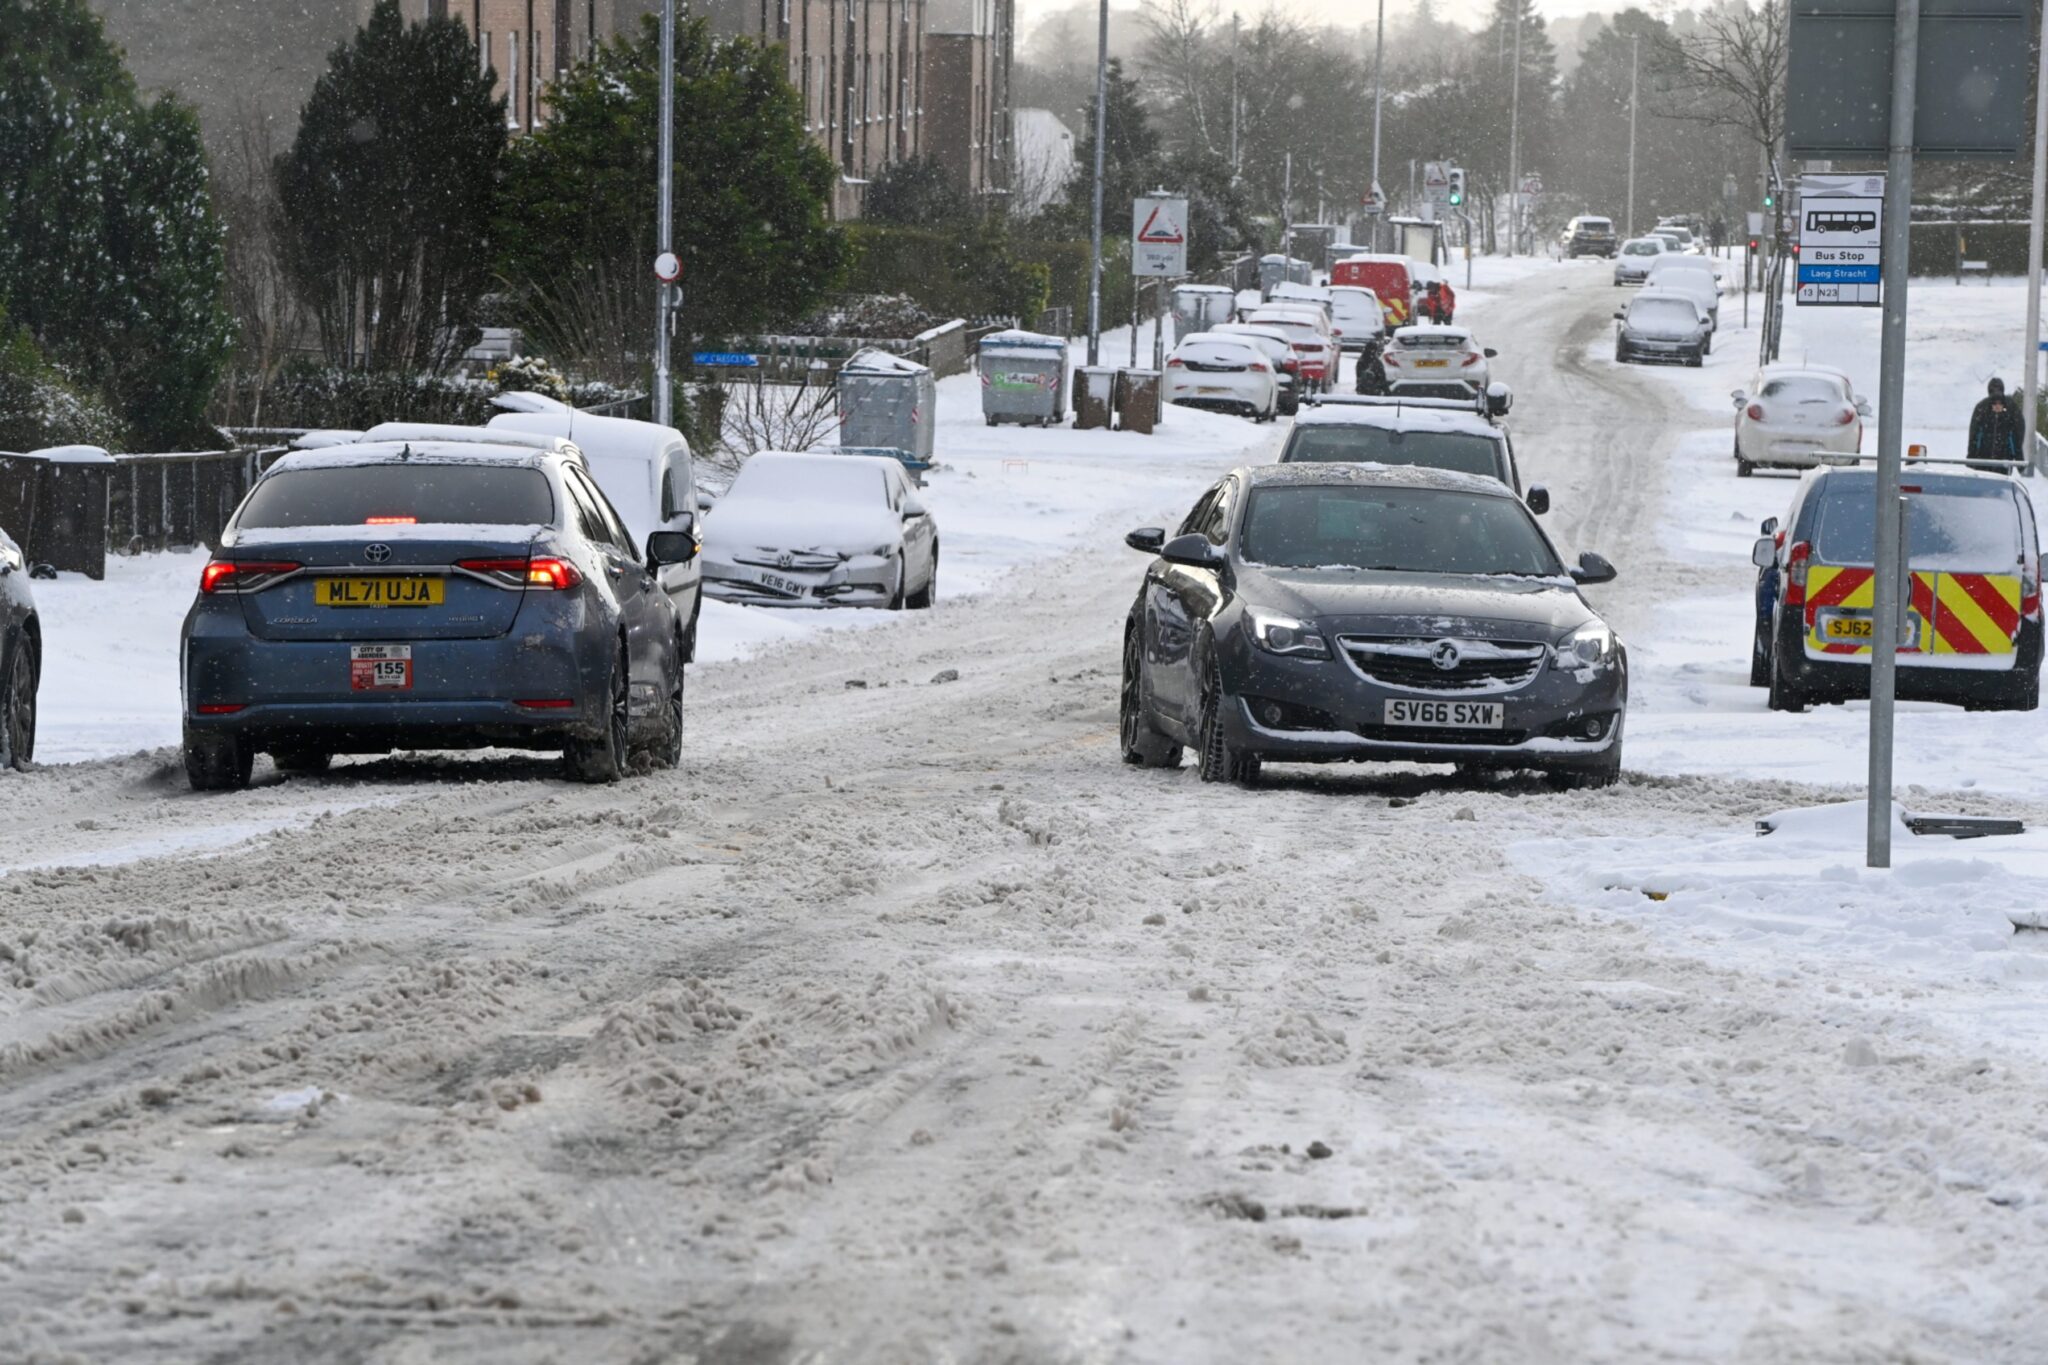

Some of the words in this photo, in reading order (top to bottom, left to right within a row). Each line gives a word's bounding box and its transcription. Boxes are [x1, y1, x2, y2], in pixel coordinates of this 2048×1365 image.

[1815, 251, 1835, 260] Bus
[1839, 251, 1865, 261] Stop
[1811, 269, 1832, 279] Lang
[1834, 269, 1867, 278] Stracht
[1803, 288, 1813, 297] 13
[1819, 289, 1838, 297] N23
[761, 573, 784, 588] VE16
[329, 581, 381, 601] ML71
[386, 581, 431, 601] UJA
[1833, 621, 1872, 635] SJ62
[374, 662, 404, 674] 155
[1393, 701, 1448, 722] SV66
[1454, 704, 1494, 725] SXW
